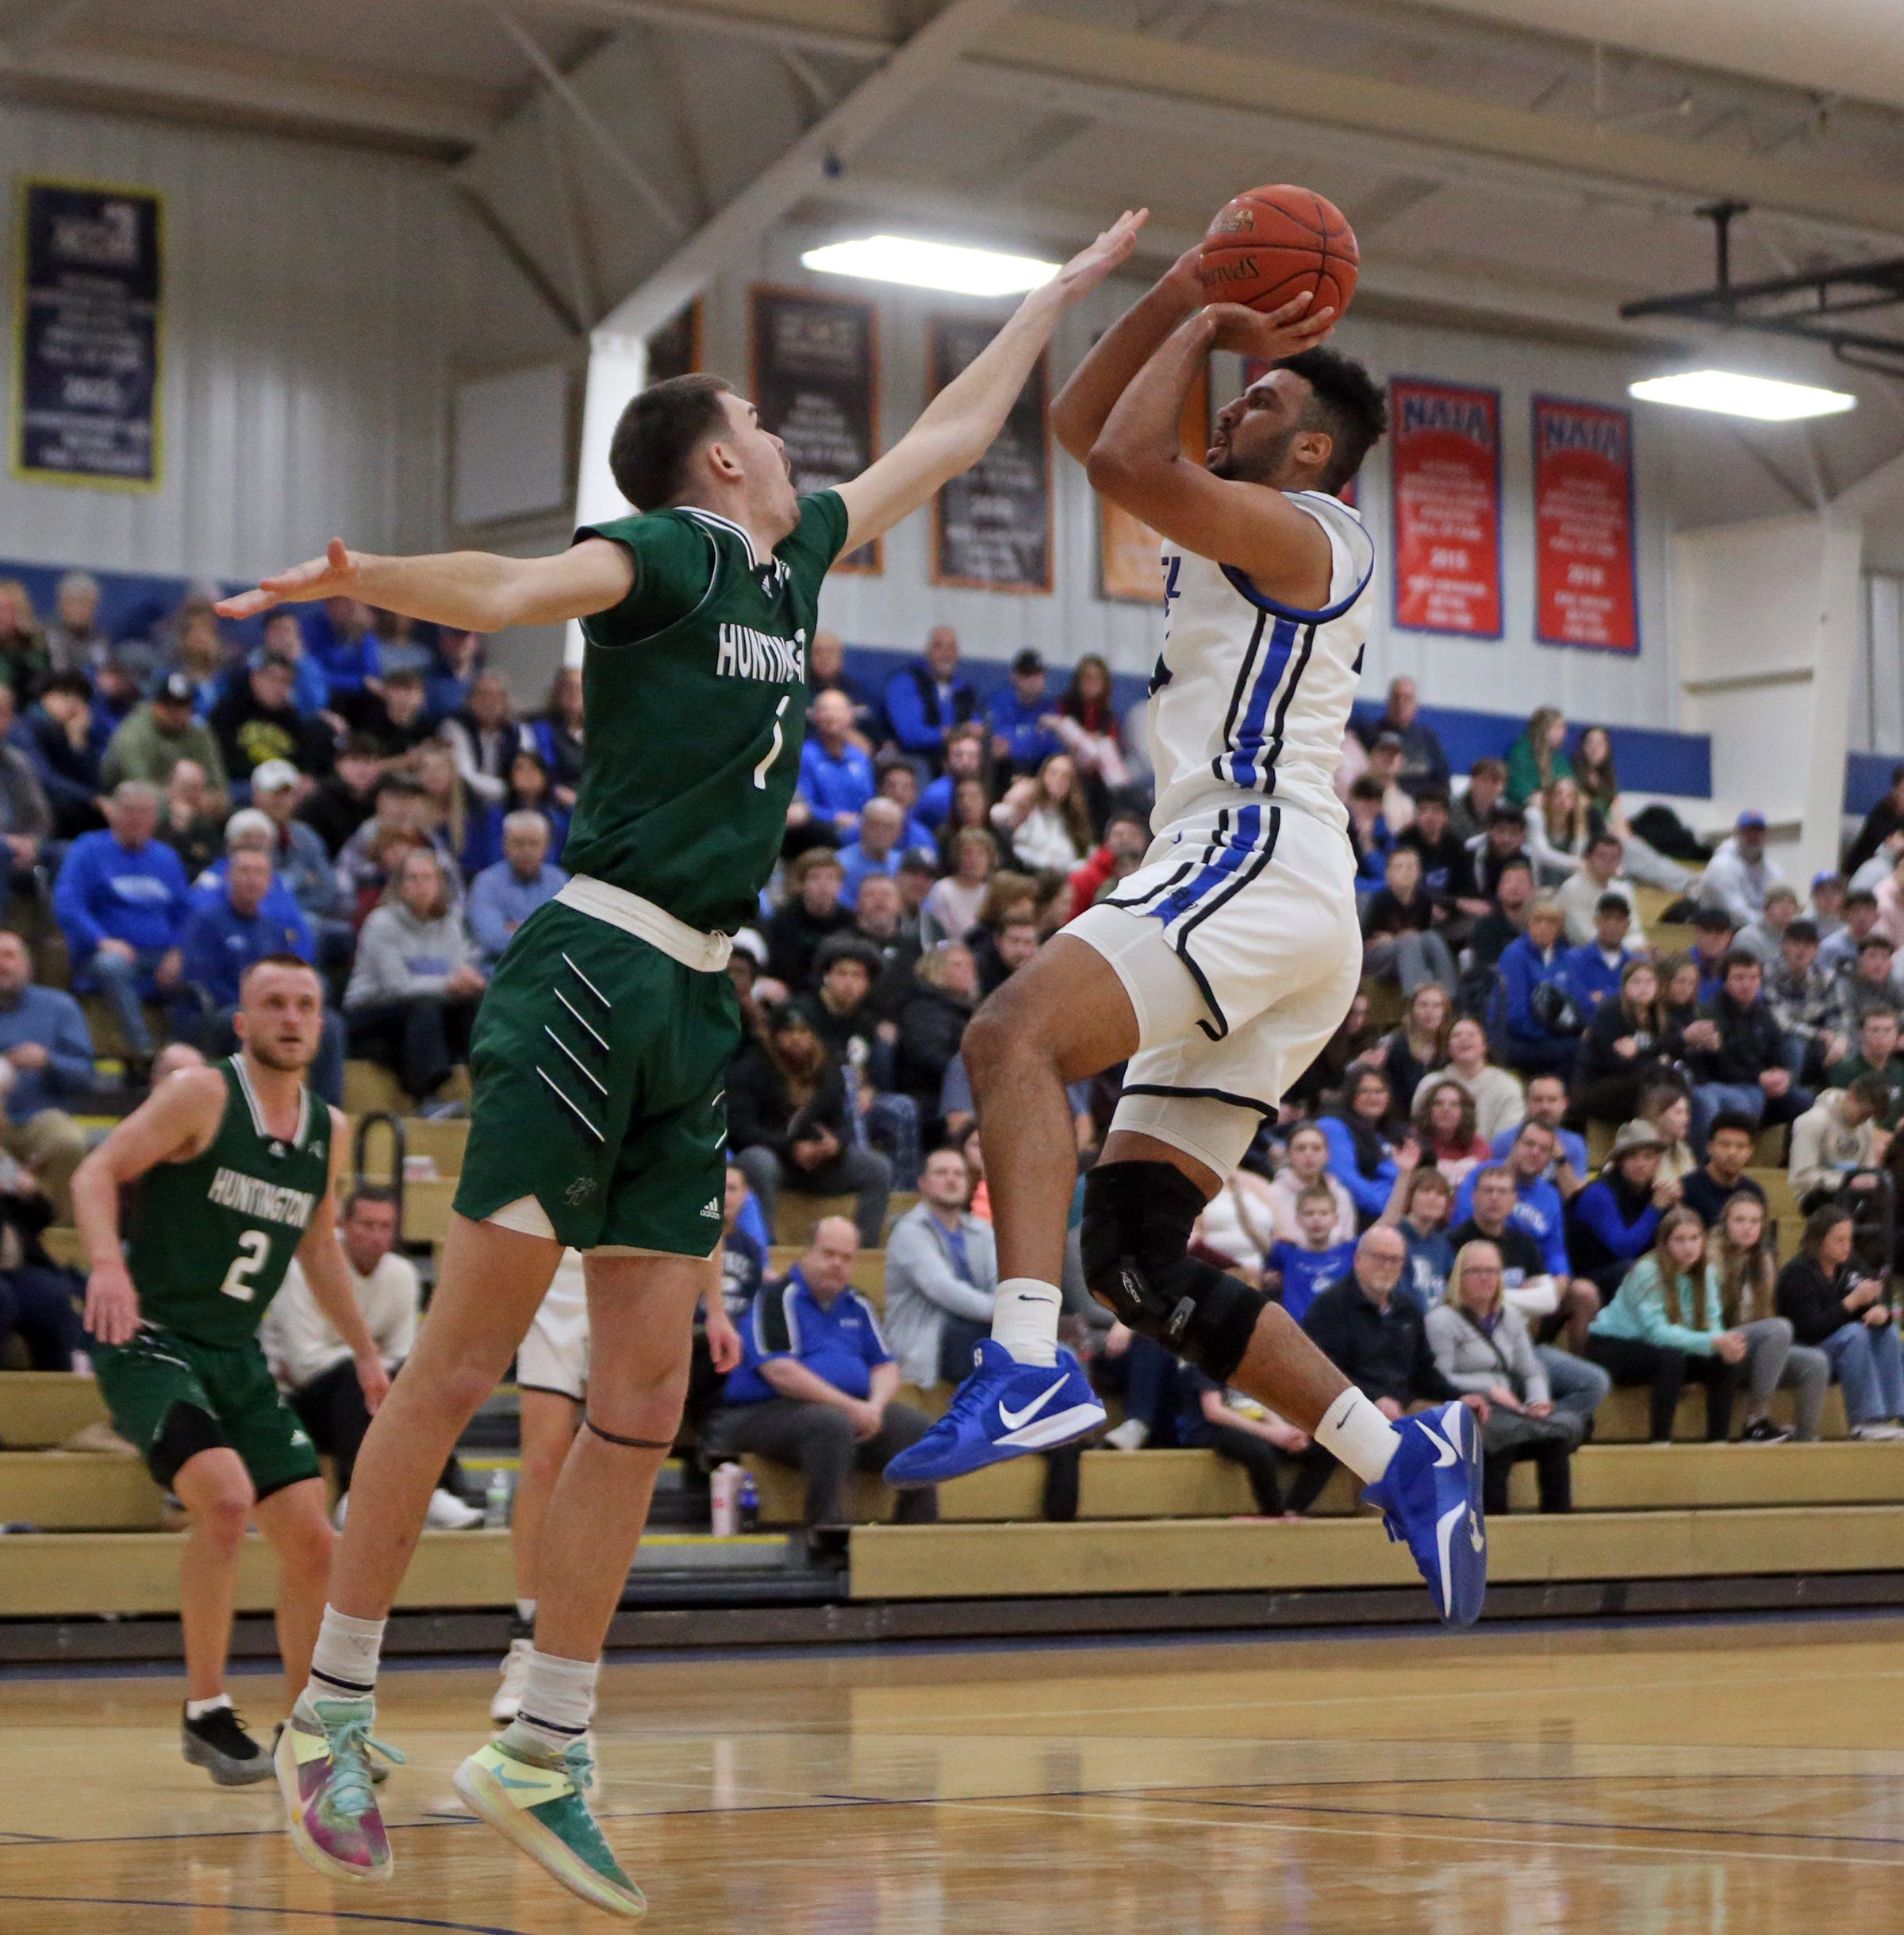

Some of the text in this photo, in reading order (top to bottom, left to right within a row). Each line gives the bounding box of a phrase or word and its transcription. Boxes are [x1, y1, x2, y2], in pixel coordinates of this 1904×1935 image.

[754, 695, 790, 789] 1
[206, 1166, 314, 1229] HUNTINGTON
[220, 1229, 271, 1302] 2
